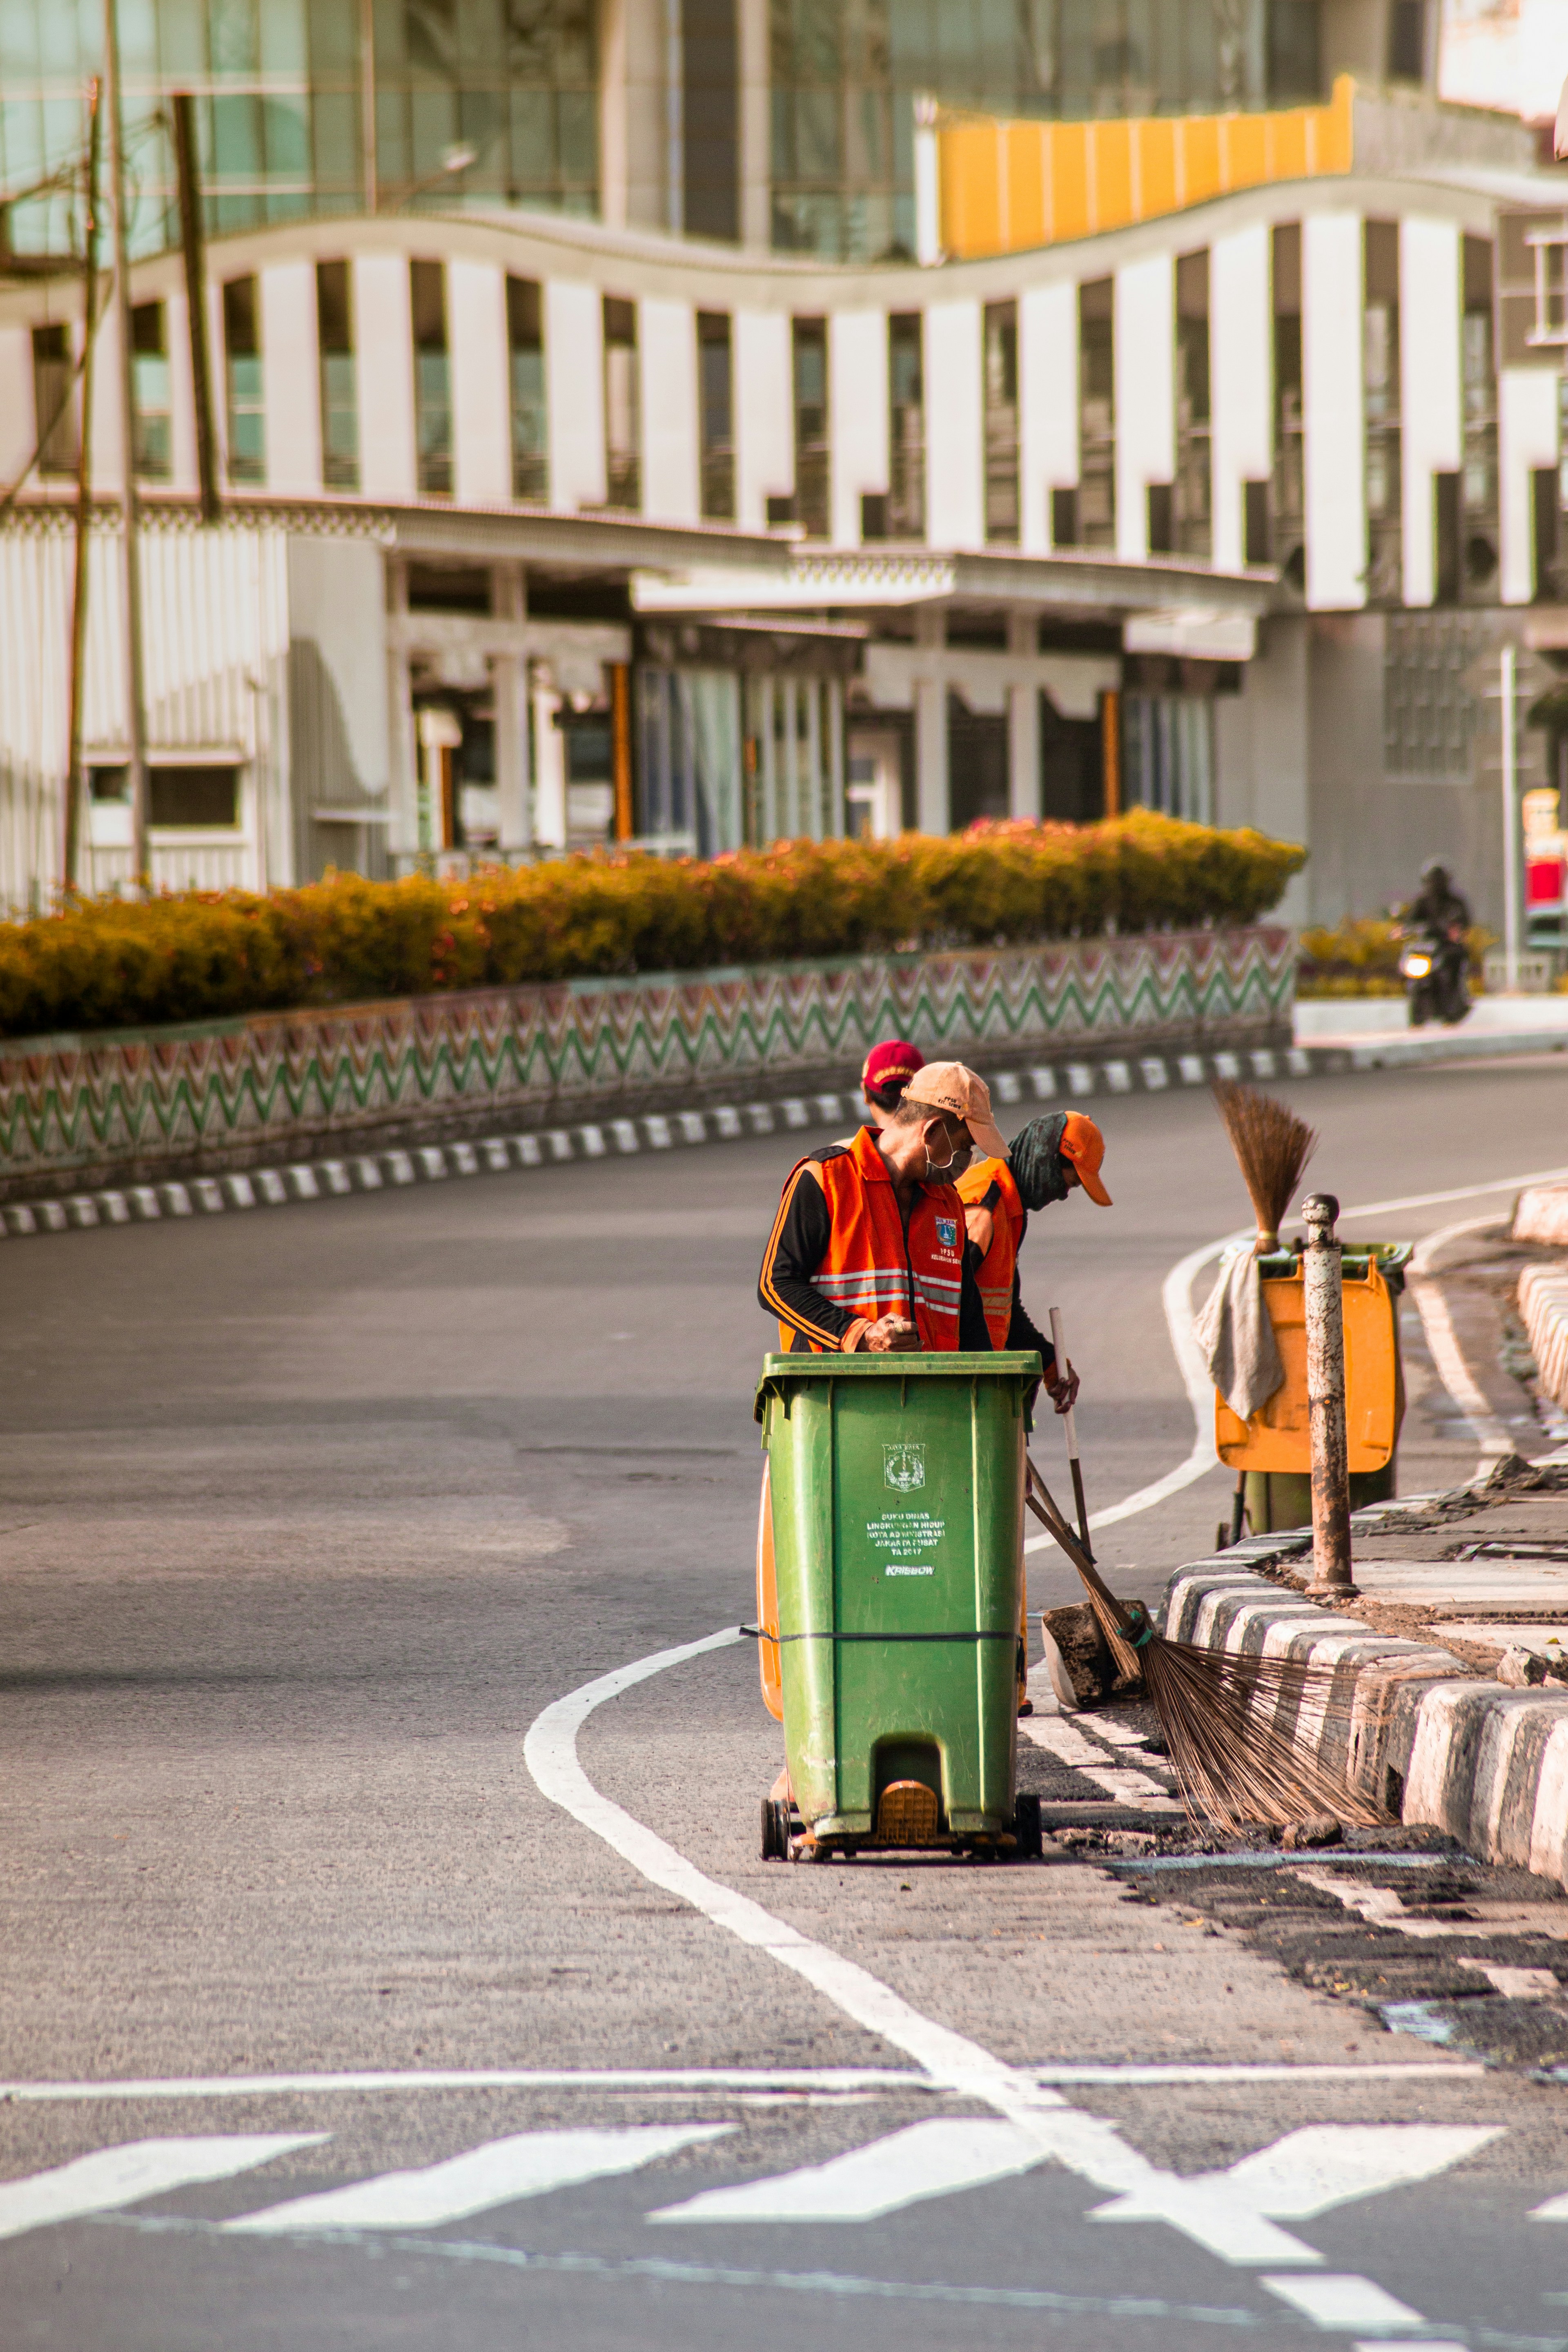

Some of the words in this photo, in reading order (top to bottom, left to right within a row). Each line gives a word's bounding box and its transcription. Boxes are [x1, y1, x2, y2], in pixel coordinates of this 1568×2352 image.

[931, 1254, 951, 1263] KELURAHAN
[906, 1512, 930, 1520] DINAS
[867, 1522, 919, 1530] LINGKGAN
[885, 1565, 935, 1576] KRISBOW
